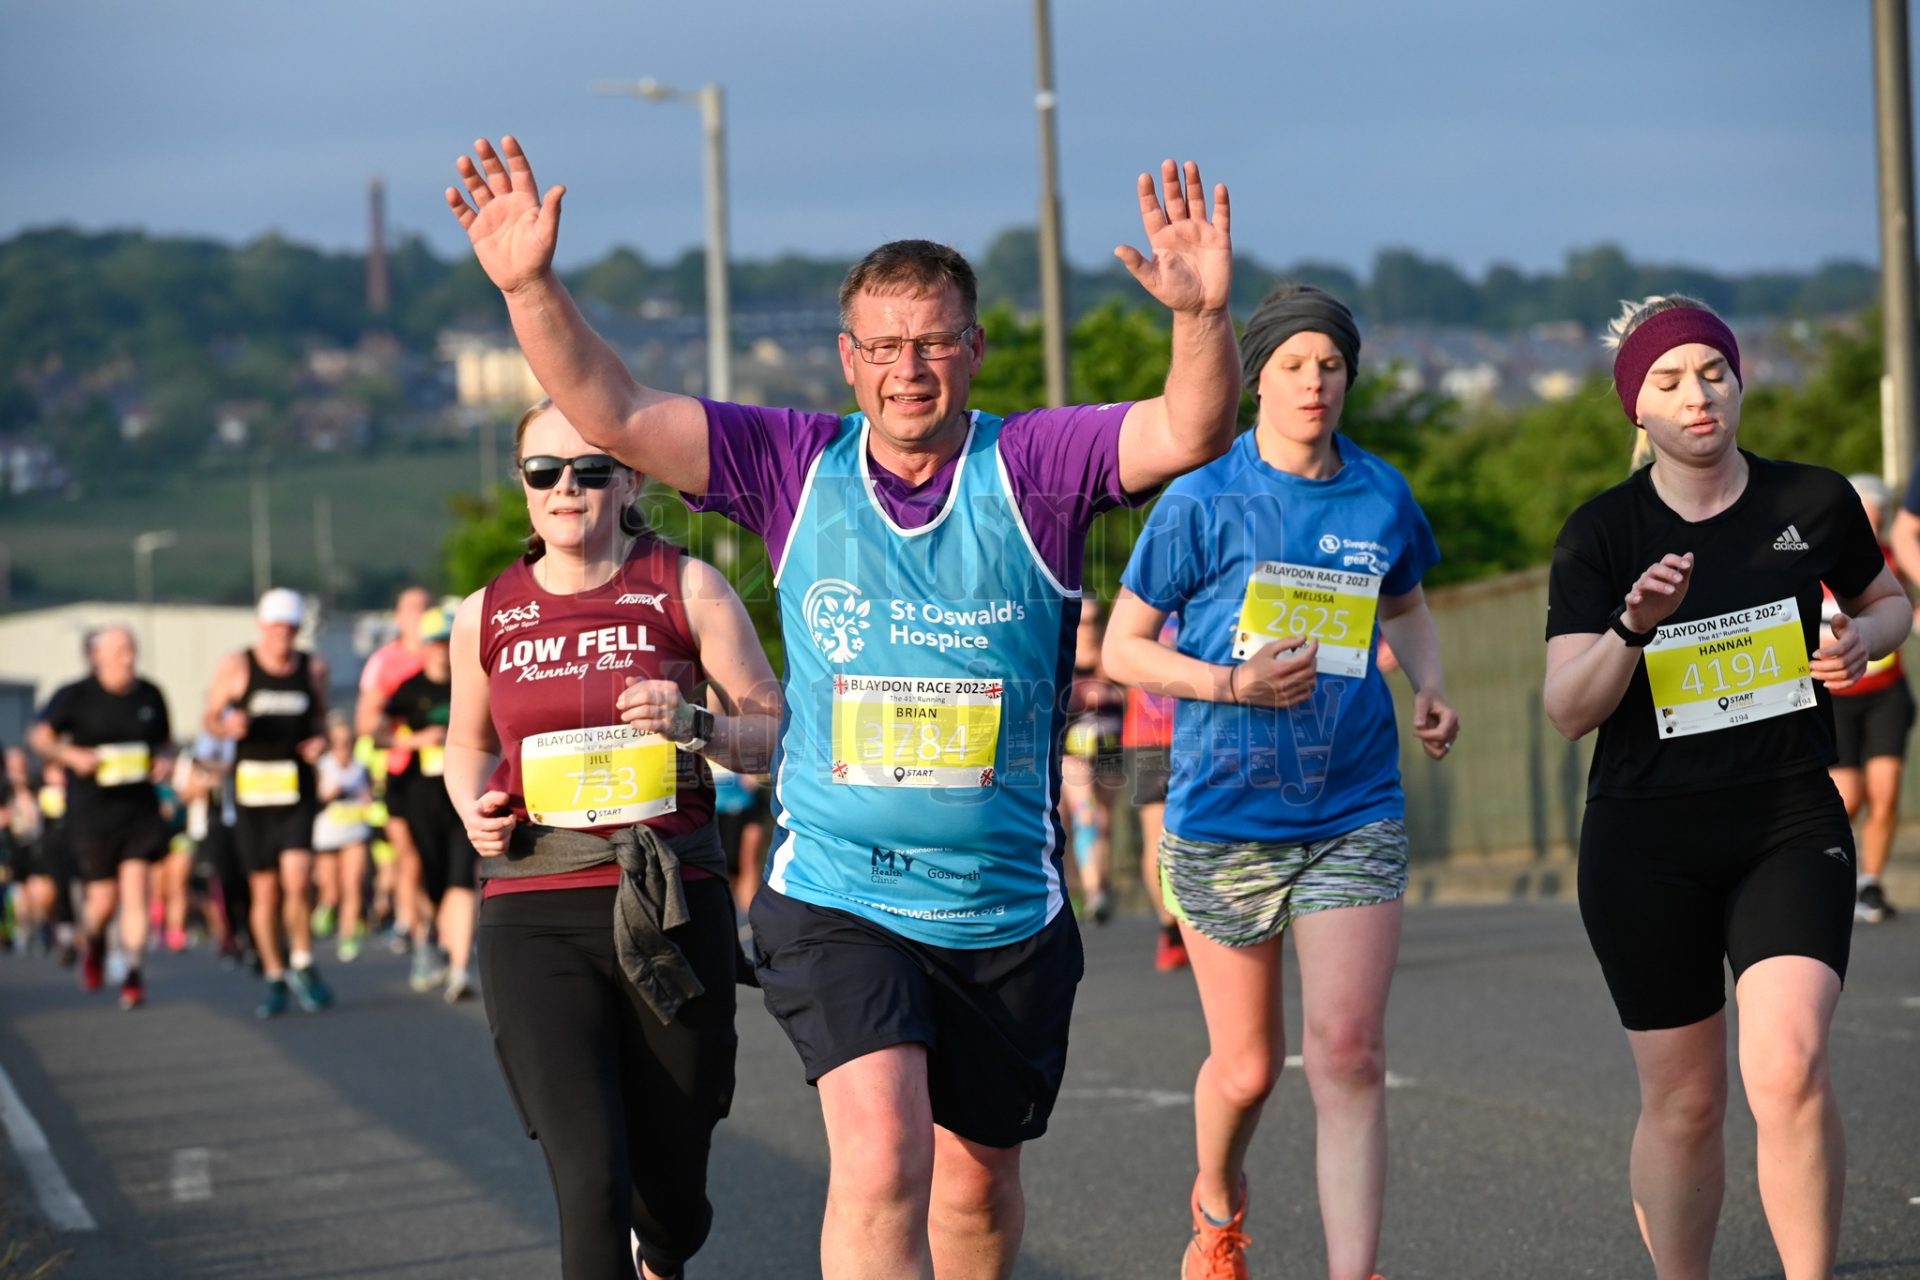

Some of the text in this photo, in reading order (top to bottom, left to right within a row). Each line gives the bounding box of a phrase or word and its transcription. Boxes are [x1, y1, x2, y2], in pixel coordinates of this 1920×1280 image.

[1773, 541, 1810, 551] adidas
[1265, 564, 1369, 587] BLAYDON RACE 2023
[1292, 590, 1335, 604] MELISSA
[890, 600, 1025, 626] St Oswald's
[1266, 601, 1351, 640] 2625
[1658, 619, 1717, 640] BLAYDON
[1720, 612, 1752, 628] RACE
[1698, 634, 1710, 642] The
[1723, 626, 1750, 638] Running
[890, 625, 989, 653] Hospice
[1698, 636, 1753, 657] HANNAH
[499, 625, 656, 673] LOW FELL
[516, 652, 634, 683] Running Club
[1681, 645, 1782, 696] 4194
[850, 679, 912, 693] BLAYDON
[917, 682, 951, 694] RACE
[917, 696, 946, 704] Running
[1730, 692, 1754, 704] START
[896, 707, 938, 719] BRIAN
[1729, 713, 1749, 724] 4194
[537, 732, 593, 748] BLAYDON
[597, 729, 628, 742] RACE
[863, 722, 969, 761] 3784
[589, 754, 612, 765] JILL
[906, 769, 934, 777] START
[564, 766, 639, 806] 733
[598, 808, 622, 817] START
[871, 847, 915, 872] MY
[871, 866, 903, 877] Health
[927, 867, 981, 881] Gosforth
[871, 875, 898, 885] Clinic
